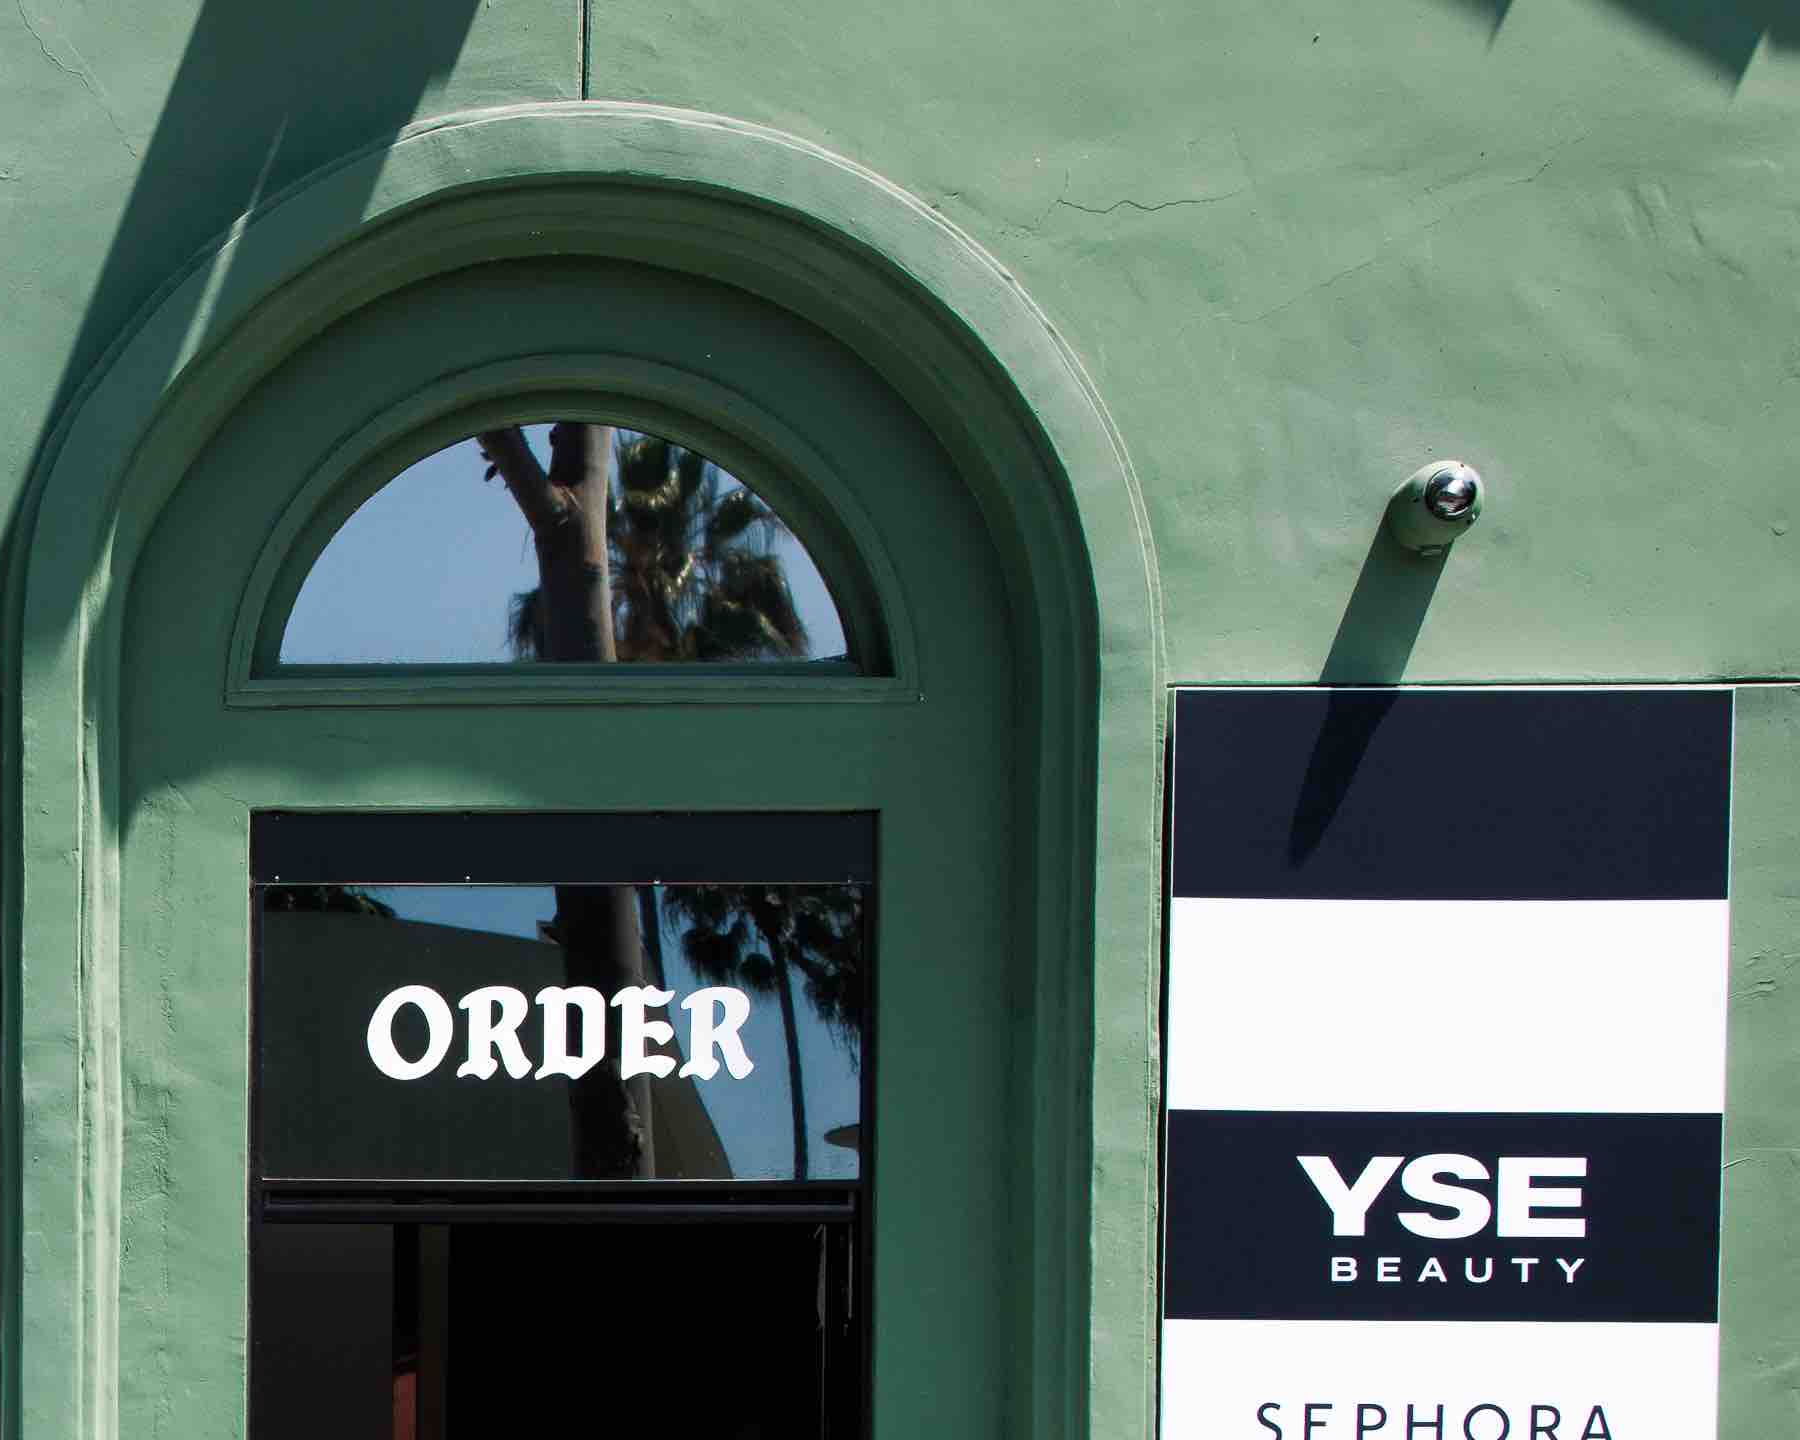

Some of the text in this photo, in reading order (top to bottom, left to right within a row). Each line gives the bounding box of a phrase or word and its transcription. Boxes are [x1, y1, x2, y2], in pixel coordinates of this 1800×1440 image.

[367, 985, 753, 1080] ORDER
[1297, 1154, 1587, 1239] YSE
[1332, 1257, 1584, 1283] BEAUTY
